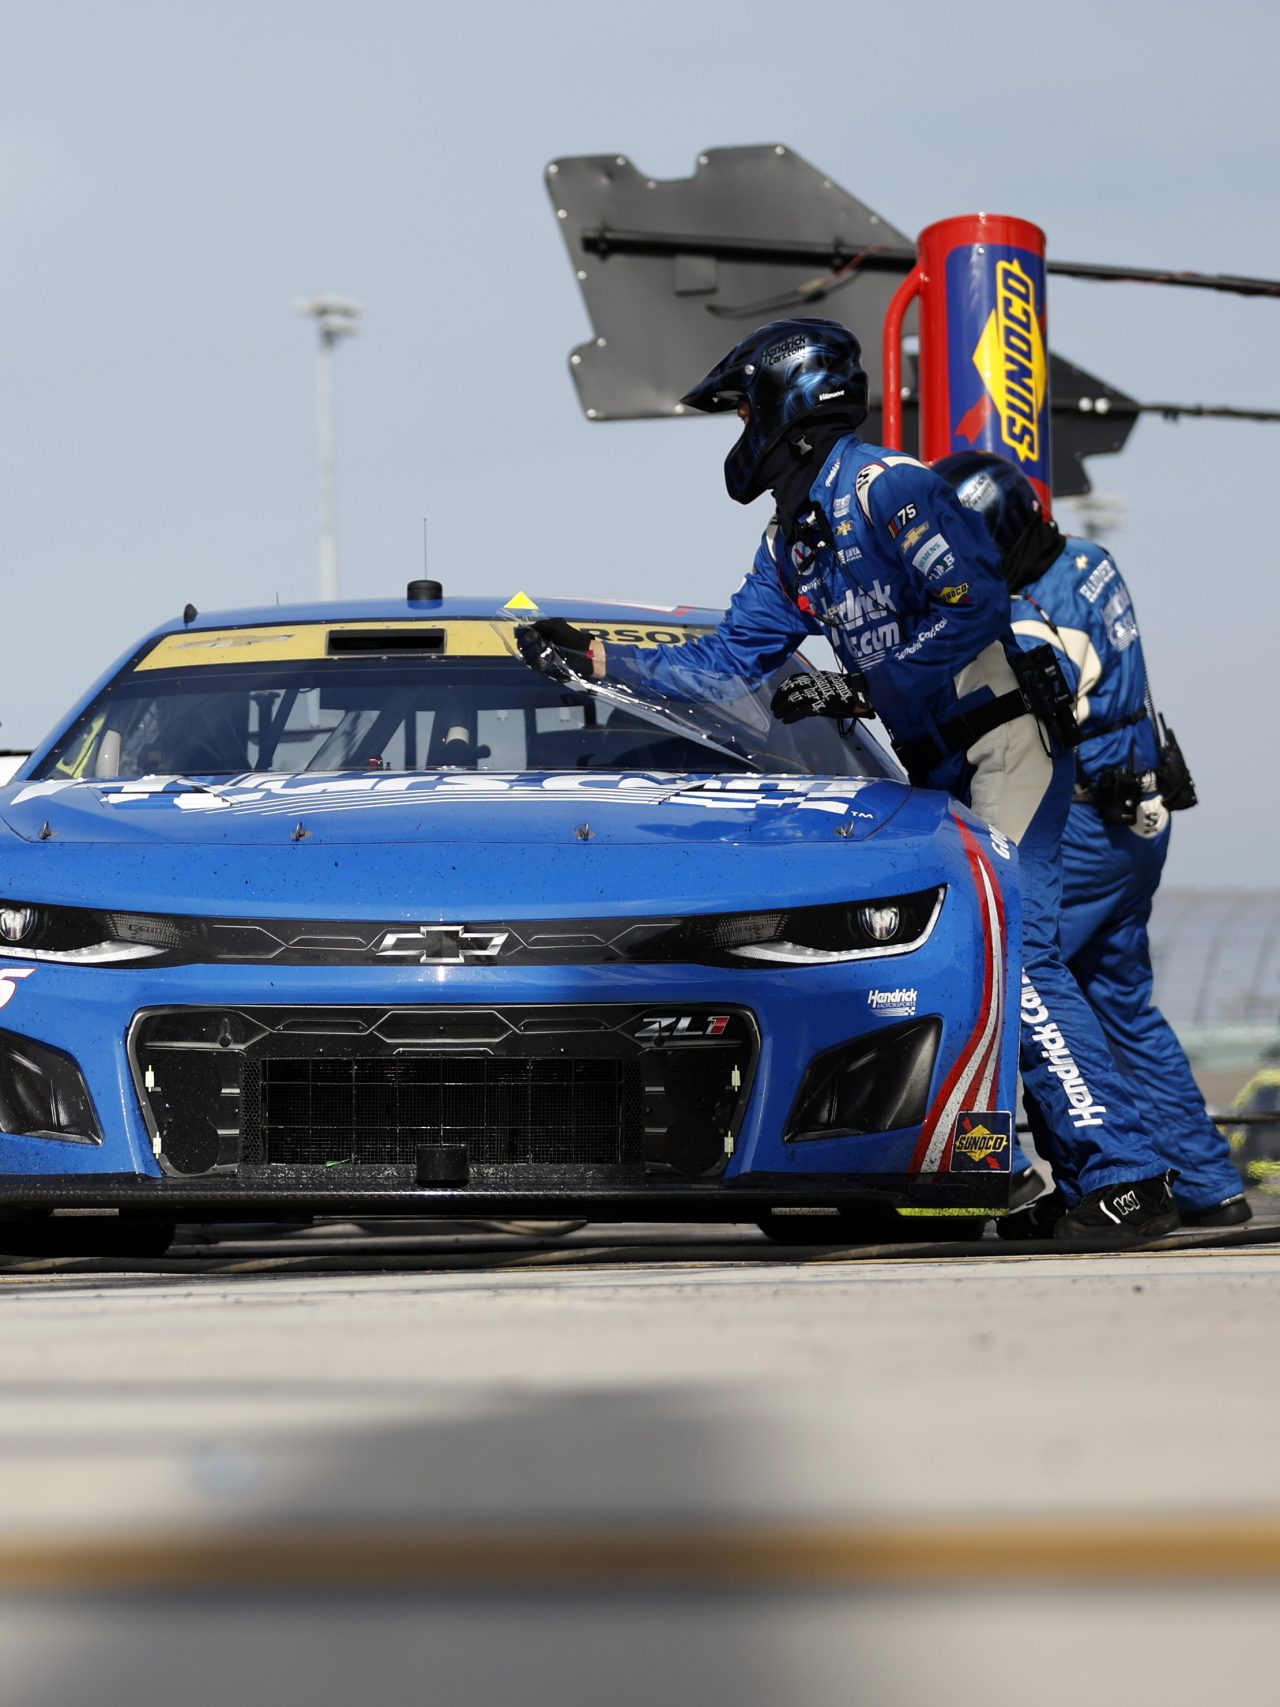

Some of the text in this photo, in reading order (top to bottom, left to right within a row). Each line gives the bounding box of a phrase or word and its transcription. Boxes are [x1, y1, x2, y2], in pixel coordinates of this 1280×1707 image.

[761, 335, 806, 364] Hendrick
[769, 345, 806, 366] Cars.com
[1001, 268, 1036, 457] SUNOCO
[897, 503, 917, 526] 75
[868, 988, 918, 1008] Hendrick
[634, 1015, 731, 1038] ZL1
[956, 1135, 1005, 1151] SUNOCO
